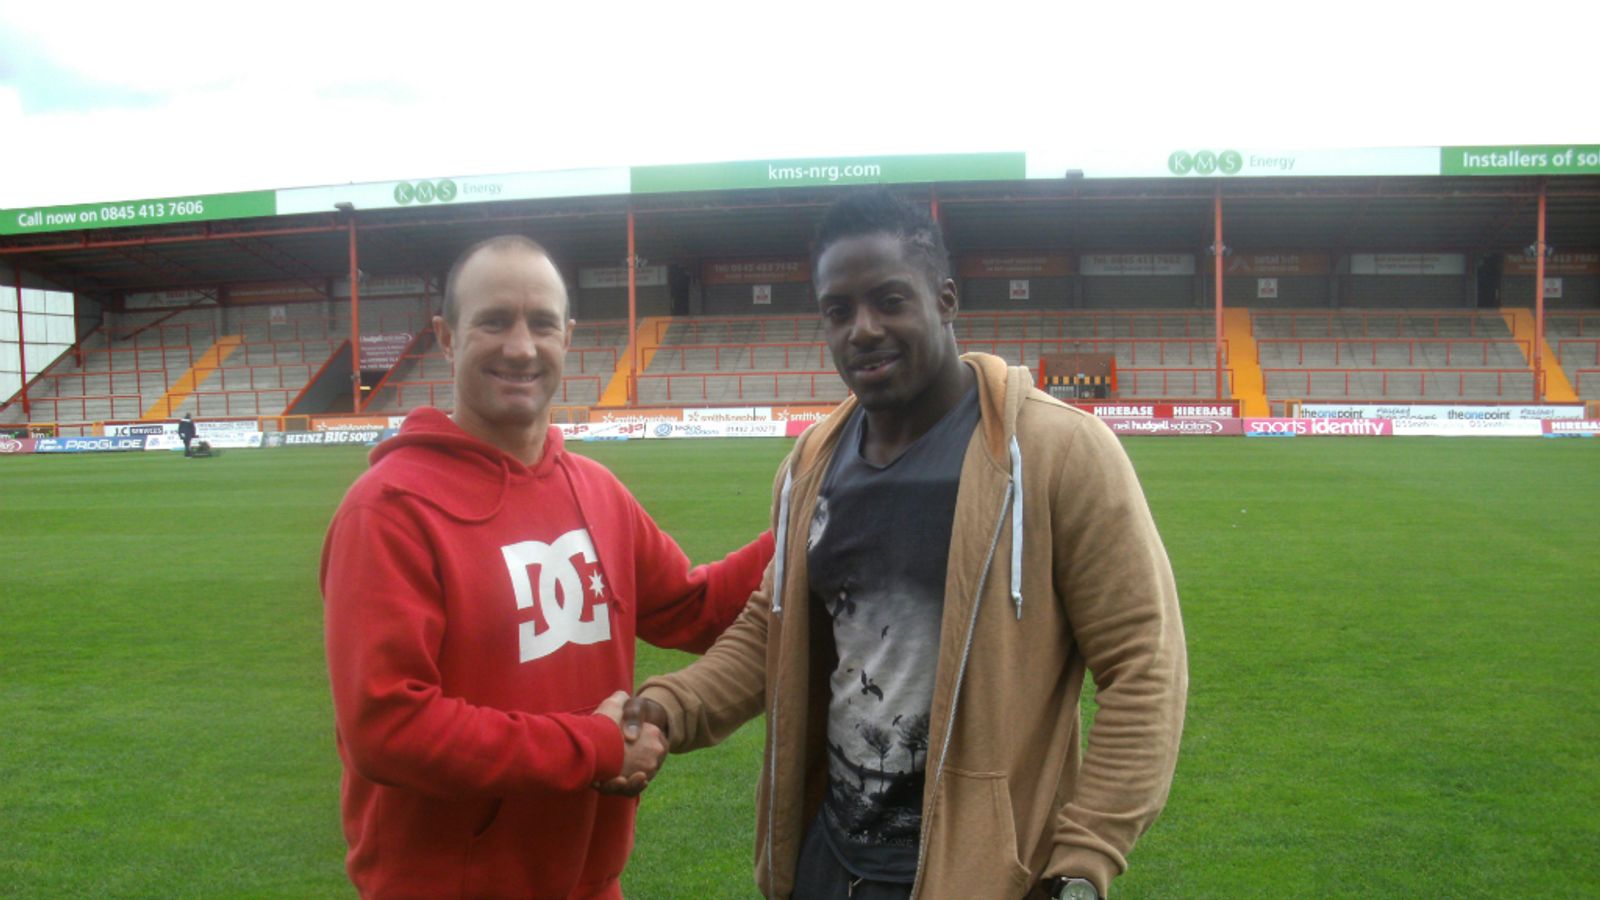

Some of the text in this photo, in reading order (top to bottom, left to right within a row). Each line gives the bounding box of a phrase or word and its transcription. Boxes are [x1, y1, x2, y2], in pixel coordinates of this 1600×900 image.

[1171, 152, 1295, 173] KMS Energy
[1463, 149, 1547, 167] Installers
[1552, 149, 1573, 166] of
[768, 163, 880, 181] kms-nrg.com
[396, 181, 503, 203] KMS Energy
[18, 200, 204, 227] Call now on 0845 413 7606
[1093, 406, 1233, 416] HIREBASE HIREBASE
[1132, 420, 1169, 432] hudgell
[1250, 418, 1385, 435] sports identity
[286, 431, 378, 444] HEINZ BIG SOUP
